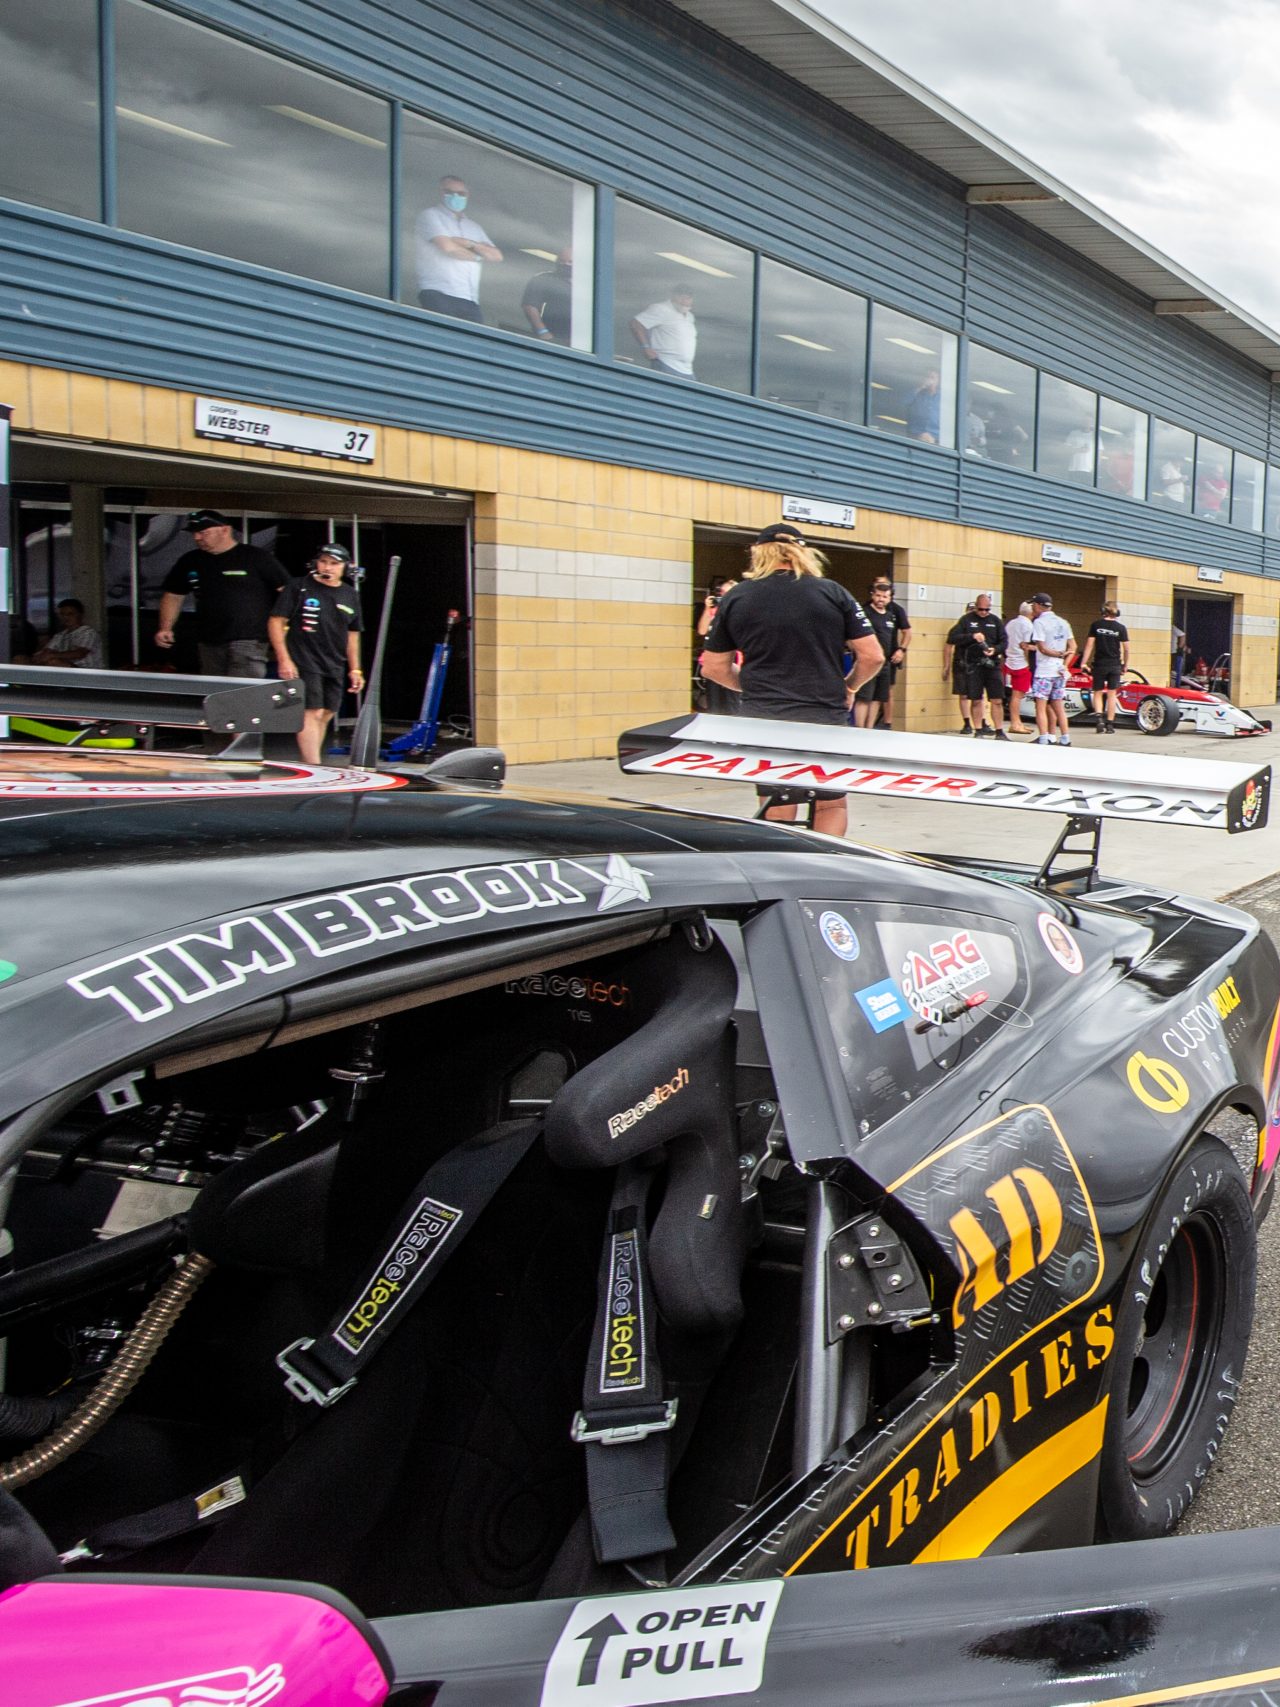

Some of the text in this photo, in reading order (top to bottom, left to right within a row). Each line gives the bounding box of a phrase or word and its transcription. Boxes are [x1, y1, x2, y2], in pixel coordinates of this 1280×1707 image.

[207, 414, 271, 437] WEBSTER
[209, 404, 238, 416] COOPER
[343, 430, 370, 452] 37
[67, 858, 586, 1022] TIM BROOK
[911, 932, 983, 990] ARG
[607, 1066, 690, 1139] Racetech
[346, 1212, 449, 1334] Racetech
[609, 1240, 638, 1377] Racetech
[846, 1304, 1115, 1570] TRADIES
[636, 1600, 767, 1635] OPEN
[620, 1637, 744, 1680] PULL
